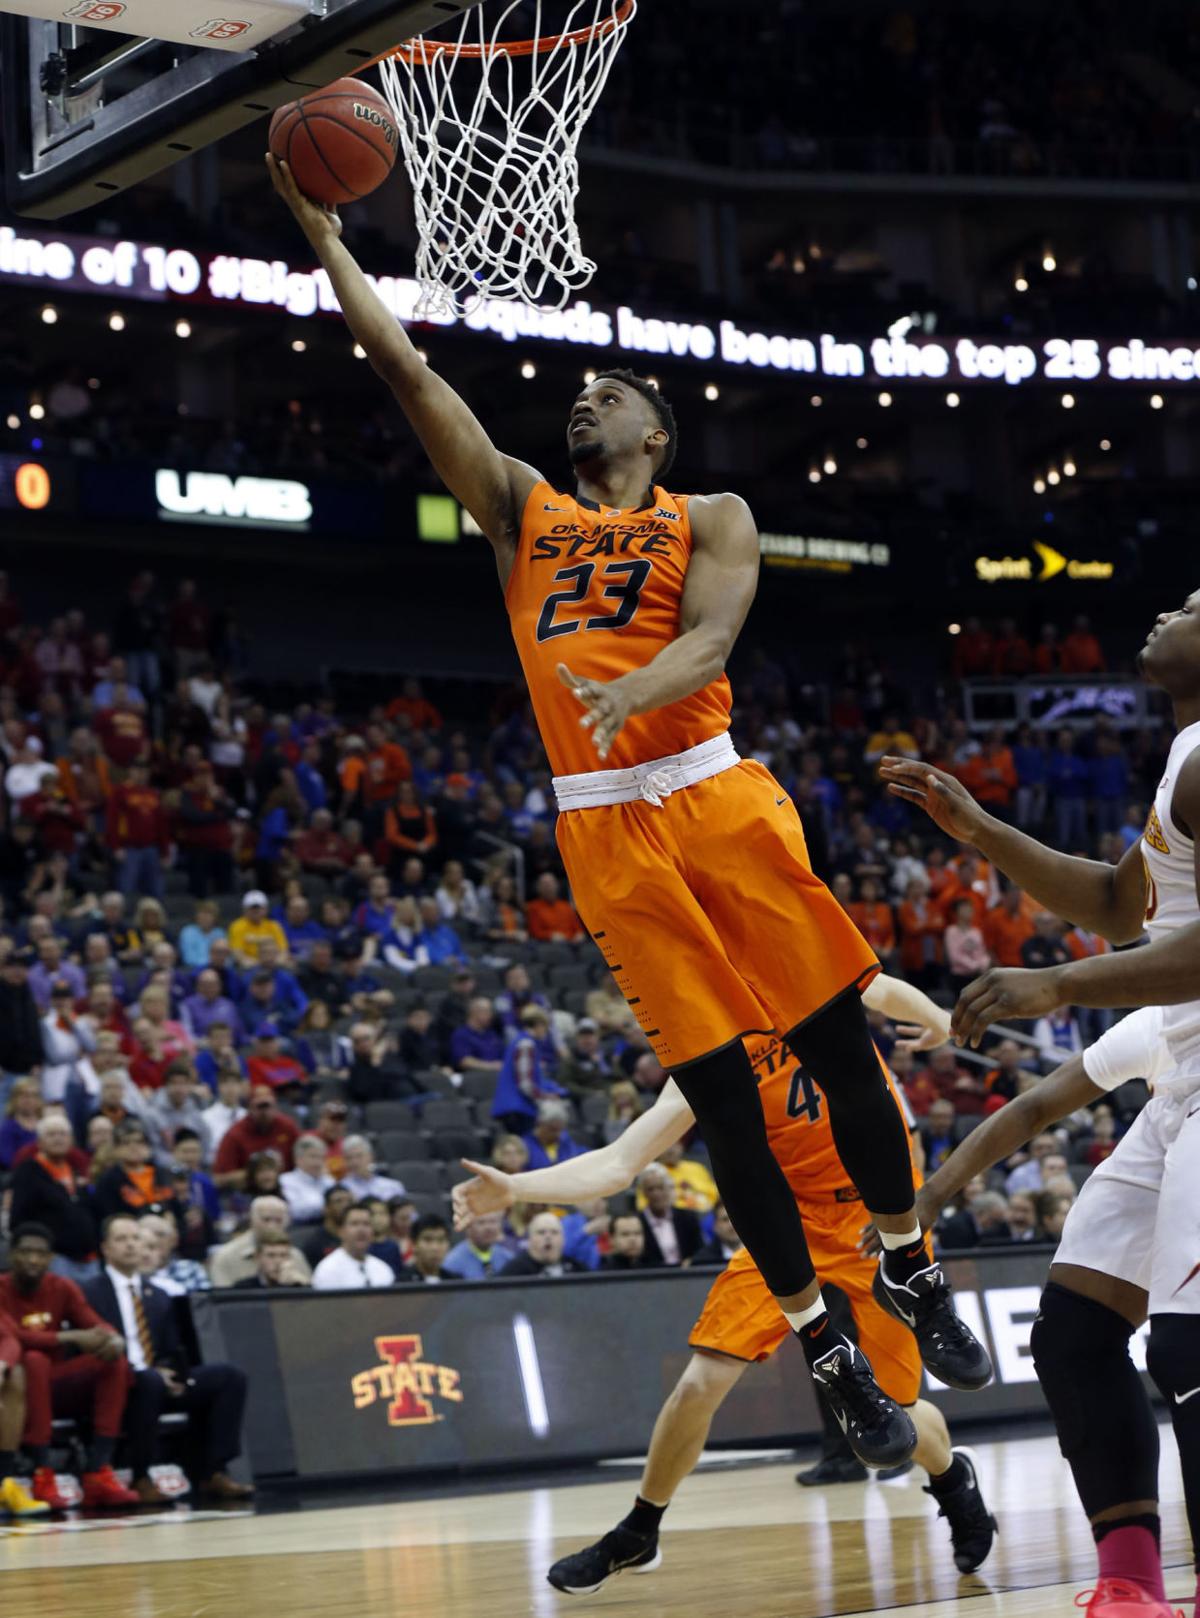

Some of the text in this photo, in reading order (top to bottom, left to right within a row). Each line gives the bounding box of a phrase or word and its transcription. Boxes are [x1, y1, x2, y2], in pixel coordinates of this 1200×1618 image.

[82, 241, 137, 287] of
[143, 247, 201, 294] 10
[463, 296, 612, 346] squads
[617, 306, 716, 359] have
[720, 320, 816, 373] been
[820, 333, 865, 377] in
[871, 334, 949, 378] the
[955, 338, 1036, 385] top
[1043, 338, 1101, 379] 25
[1108, 338, 1200, 380] sinc
[15, 462, 49, 510] 0
[155, 468, 313, 522] UMB
[530, 530, 682, 561] STATE
[551, 520, 669, 538] OKLAHOMA
[975, 556, 1031, 583] Sprint
[536, 558, 653, 643] 23
[785, 1066, 822, 1124] 4
[351, 1361, 464, 1409] STATE
